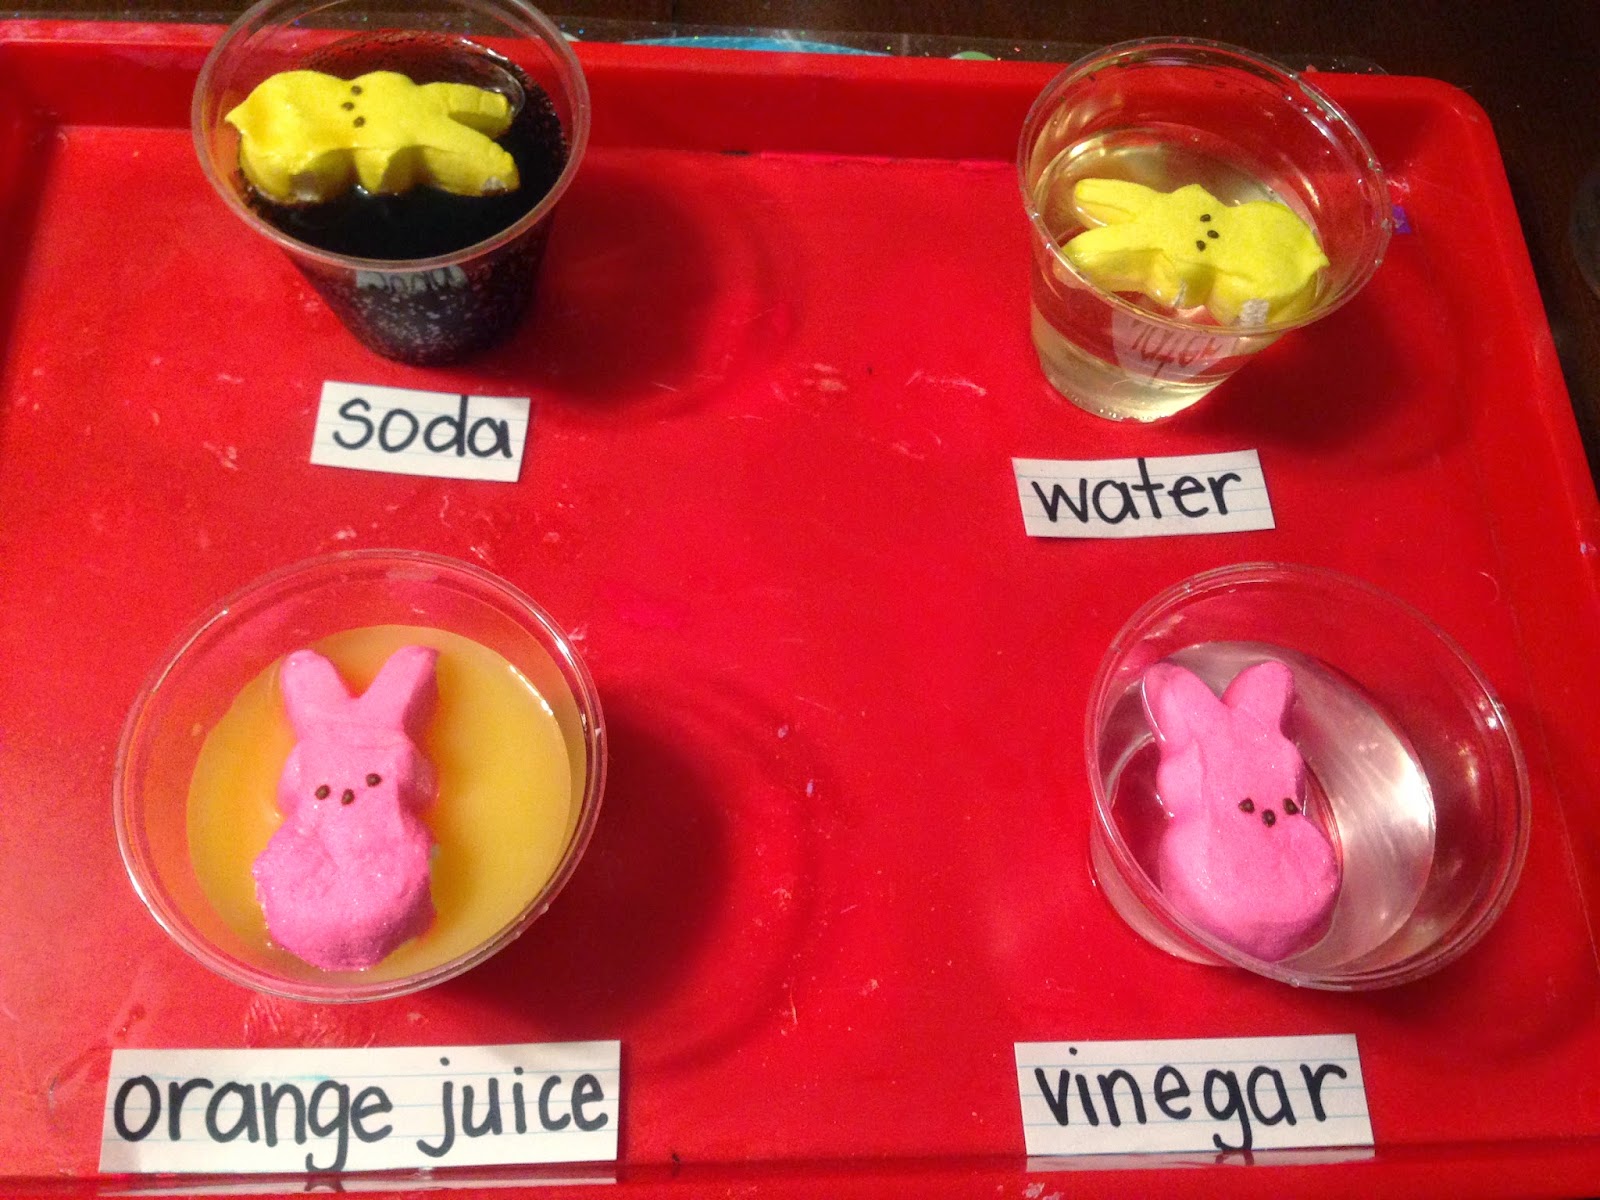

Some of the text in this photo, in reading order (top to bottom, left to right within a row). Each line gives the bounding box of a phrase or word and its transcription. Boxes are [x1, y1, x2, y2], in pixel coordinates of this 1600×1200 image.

[334, 395, 512, 457] soda
[1032, 457, 1242, 525] water
[114, 1058, 608, 1171] orange juice
[1034, 1047, 1348, 1151] vinegar
